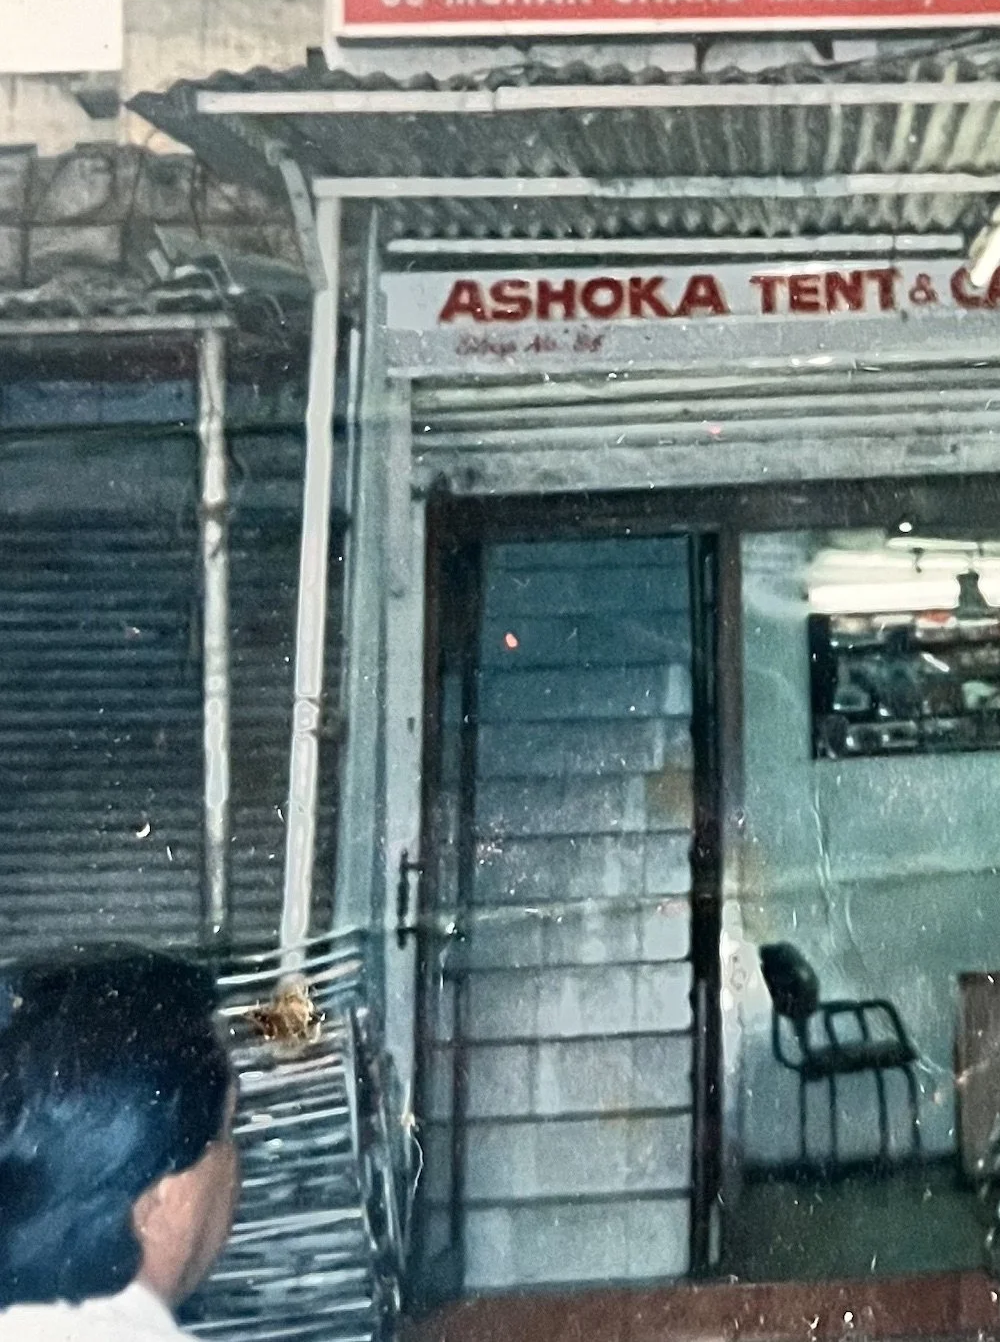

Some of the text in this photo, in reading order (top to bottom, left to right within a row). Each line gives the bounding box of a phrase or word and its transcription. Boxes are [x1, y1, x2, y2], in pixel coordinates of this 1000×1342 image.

[438, 276, 731, 322] ASHOKA
[749, 268, 902, 314] TENT
[908, 273, 939, 305] &
